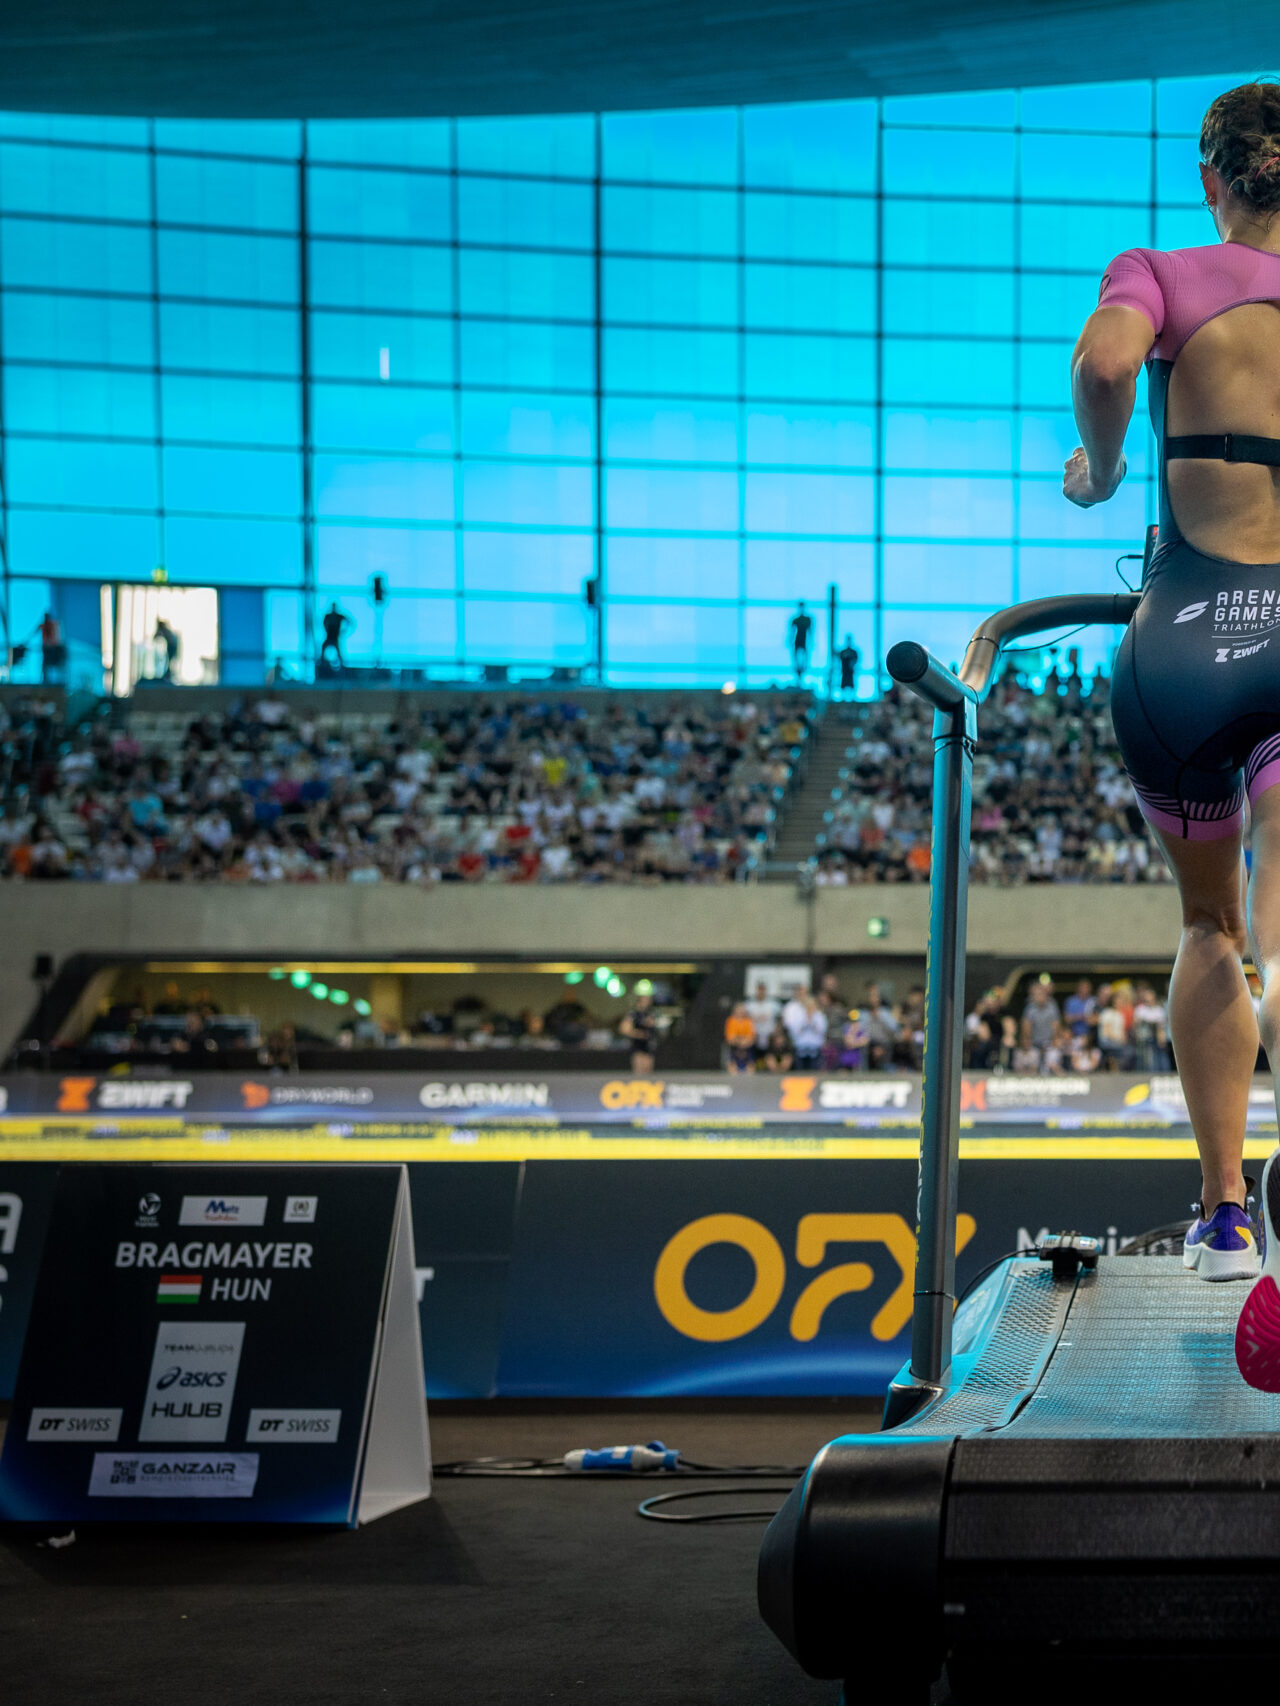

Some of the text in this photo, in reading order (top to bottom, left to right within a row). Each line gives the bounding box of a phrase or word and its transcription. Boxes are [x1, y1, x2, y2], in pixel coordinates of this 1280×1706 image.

[1232, 638, 1271, 660] ZWIFT
[420, 1082, 549, 1107] GARMIN
[115, 1241, 314, 1269] BRAGMAYER
[210, 1277, 272, 1302] HUN
[180, 1372, 227, 1388] asics
[151, 1402, 223, 1418] HUUB
[38, 1417, 112, 1432] DT SWISS
[258, 1418, 332, 1433] DT SWISS
[141, 1462, 236, 1474] GANZAIR
